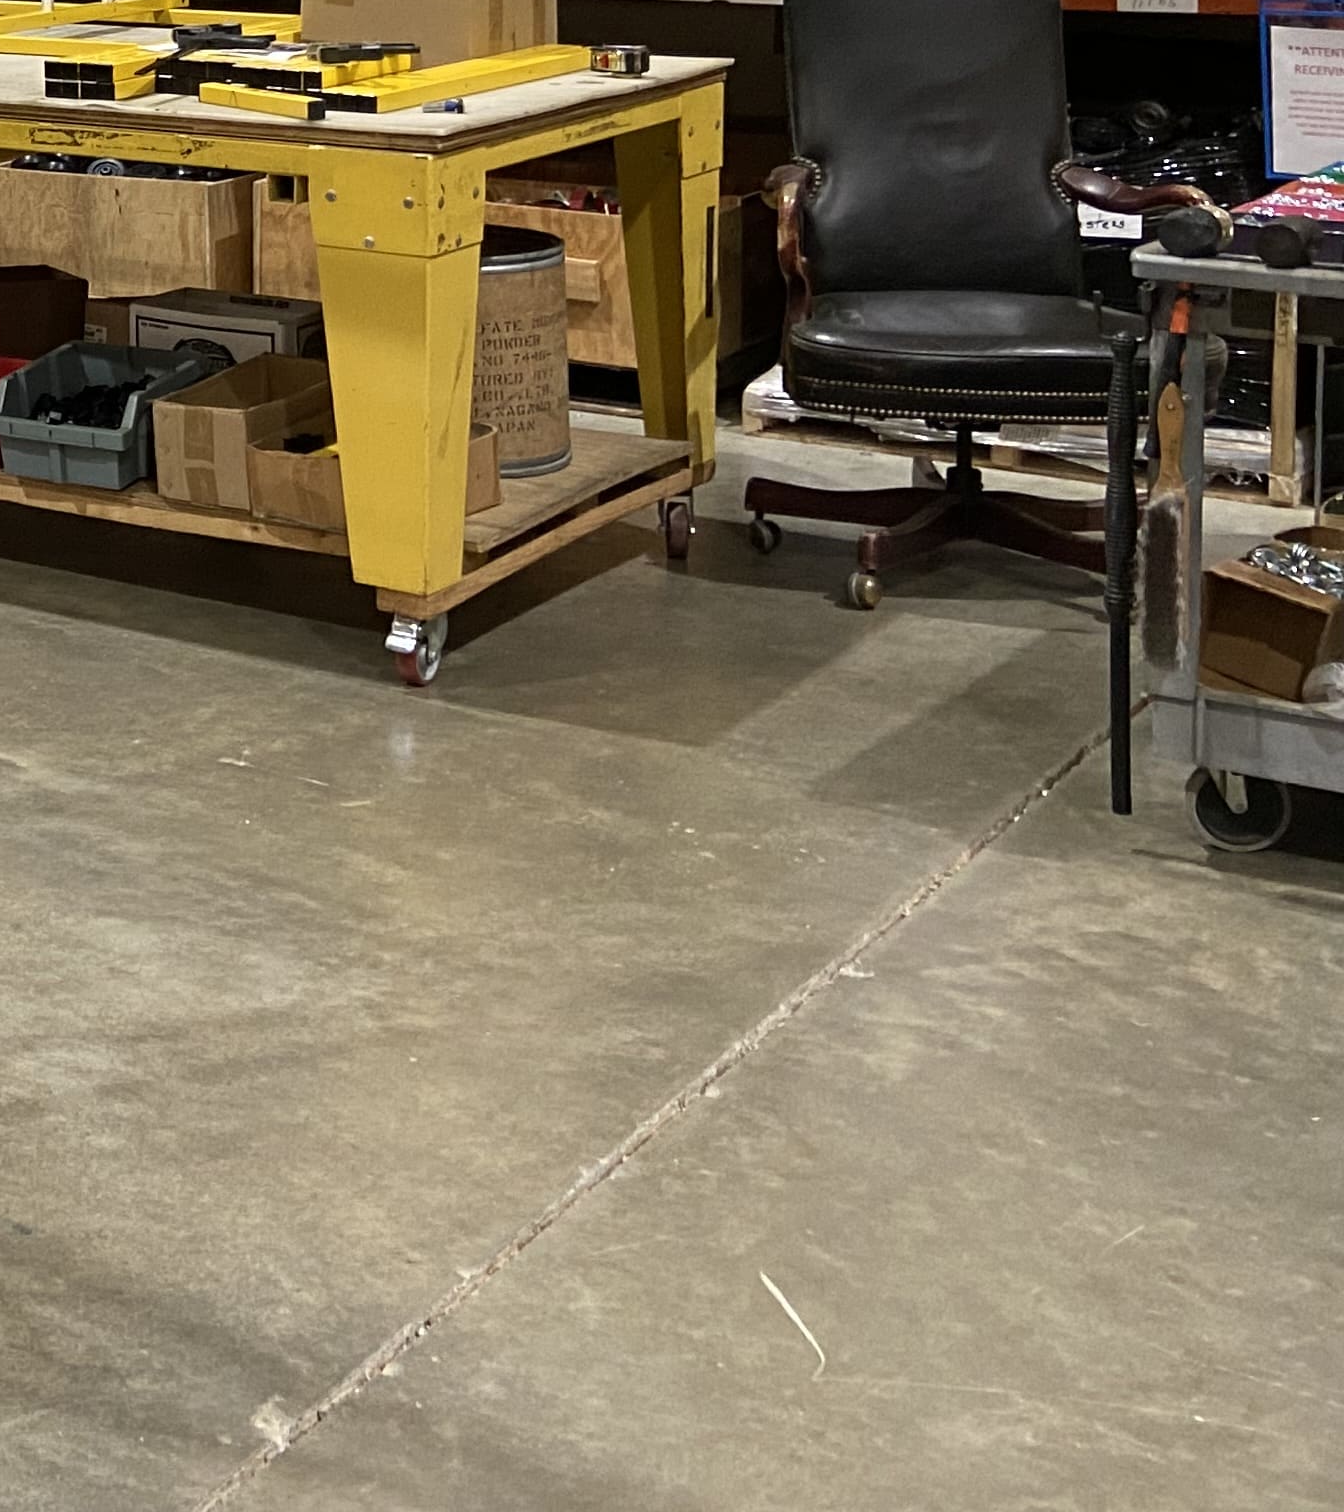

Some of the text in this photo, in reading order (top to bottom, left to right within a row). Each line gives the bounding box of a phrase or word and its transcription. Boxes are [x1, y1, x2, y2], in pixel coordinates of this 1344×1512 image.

[479, 319, 523, 335] FATE
[473, 372, 524, 387] TURED
[497, 419, 535, 433] APAN
